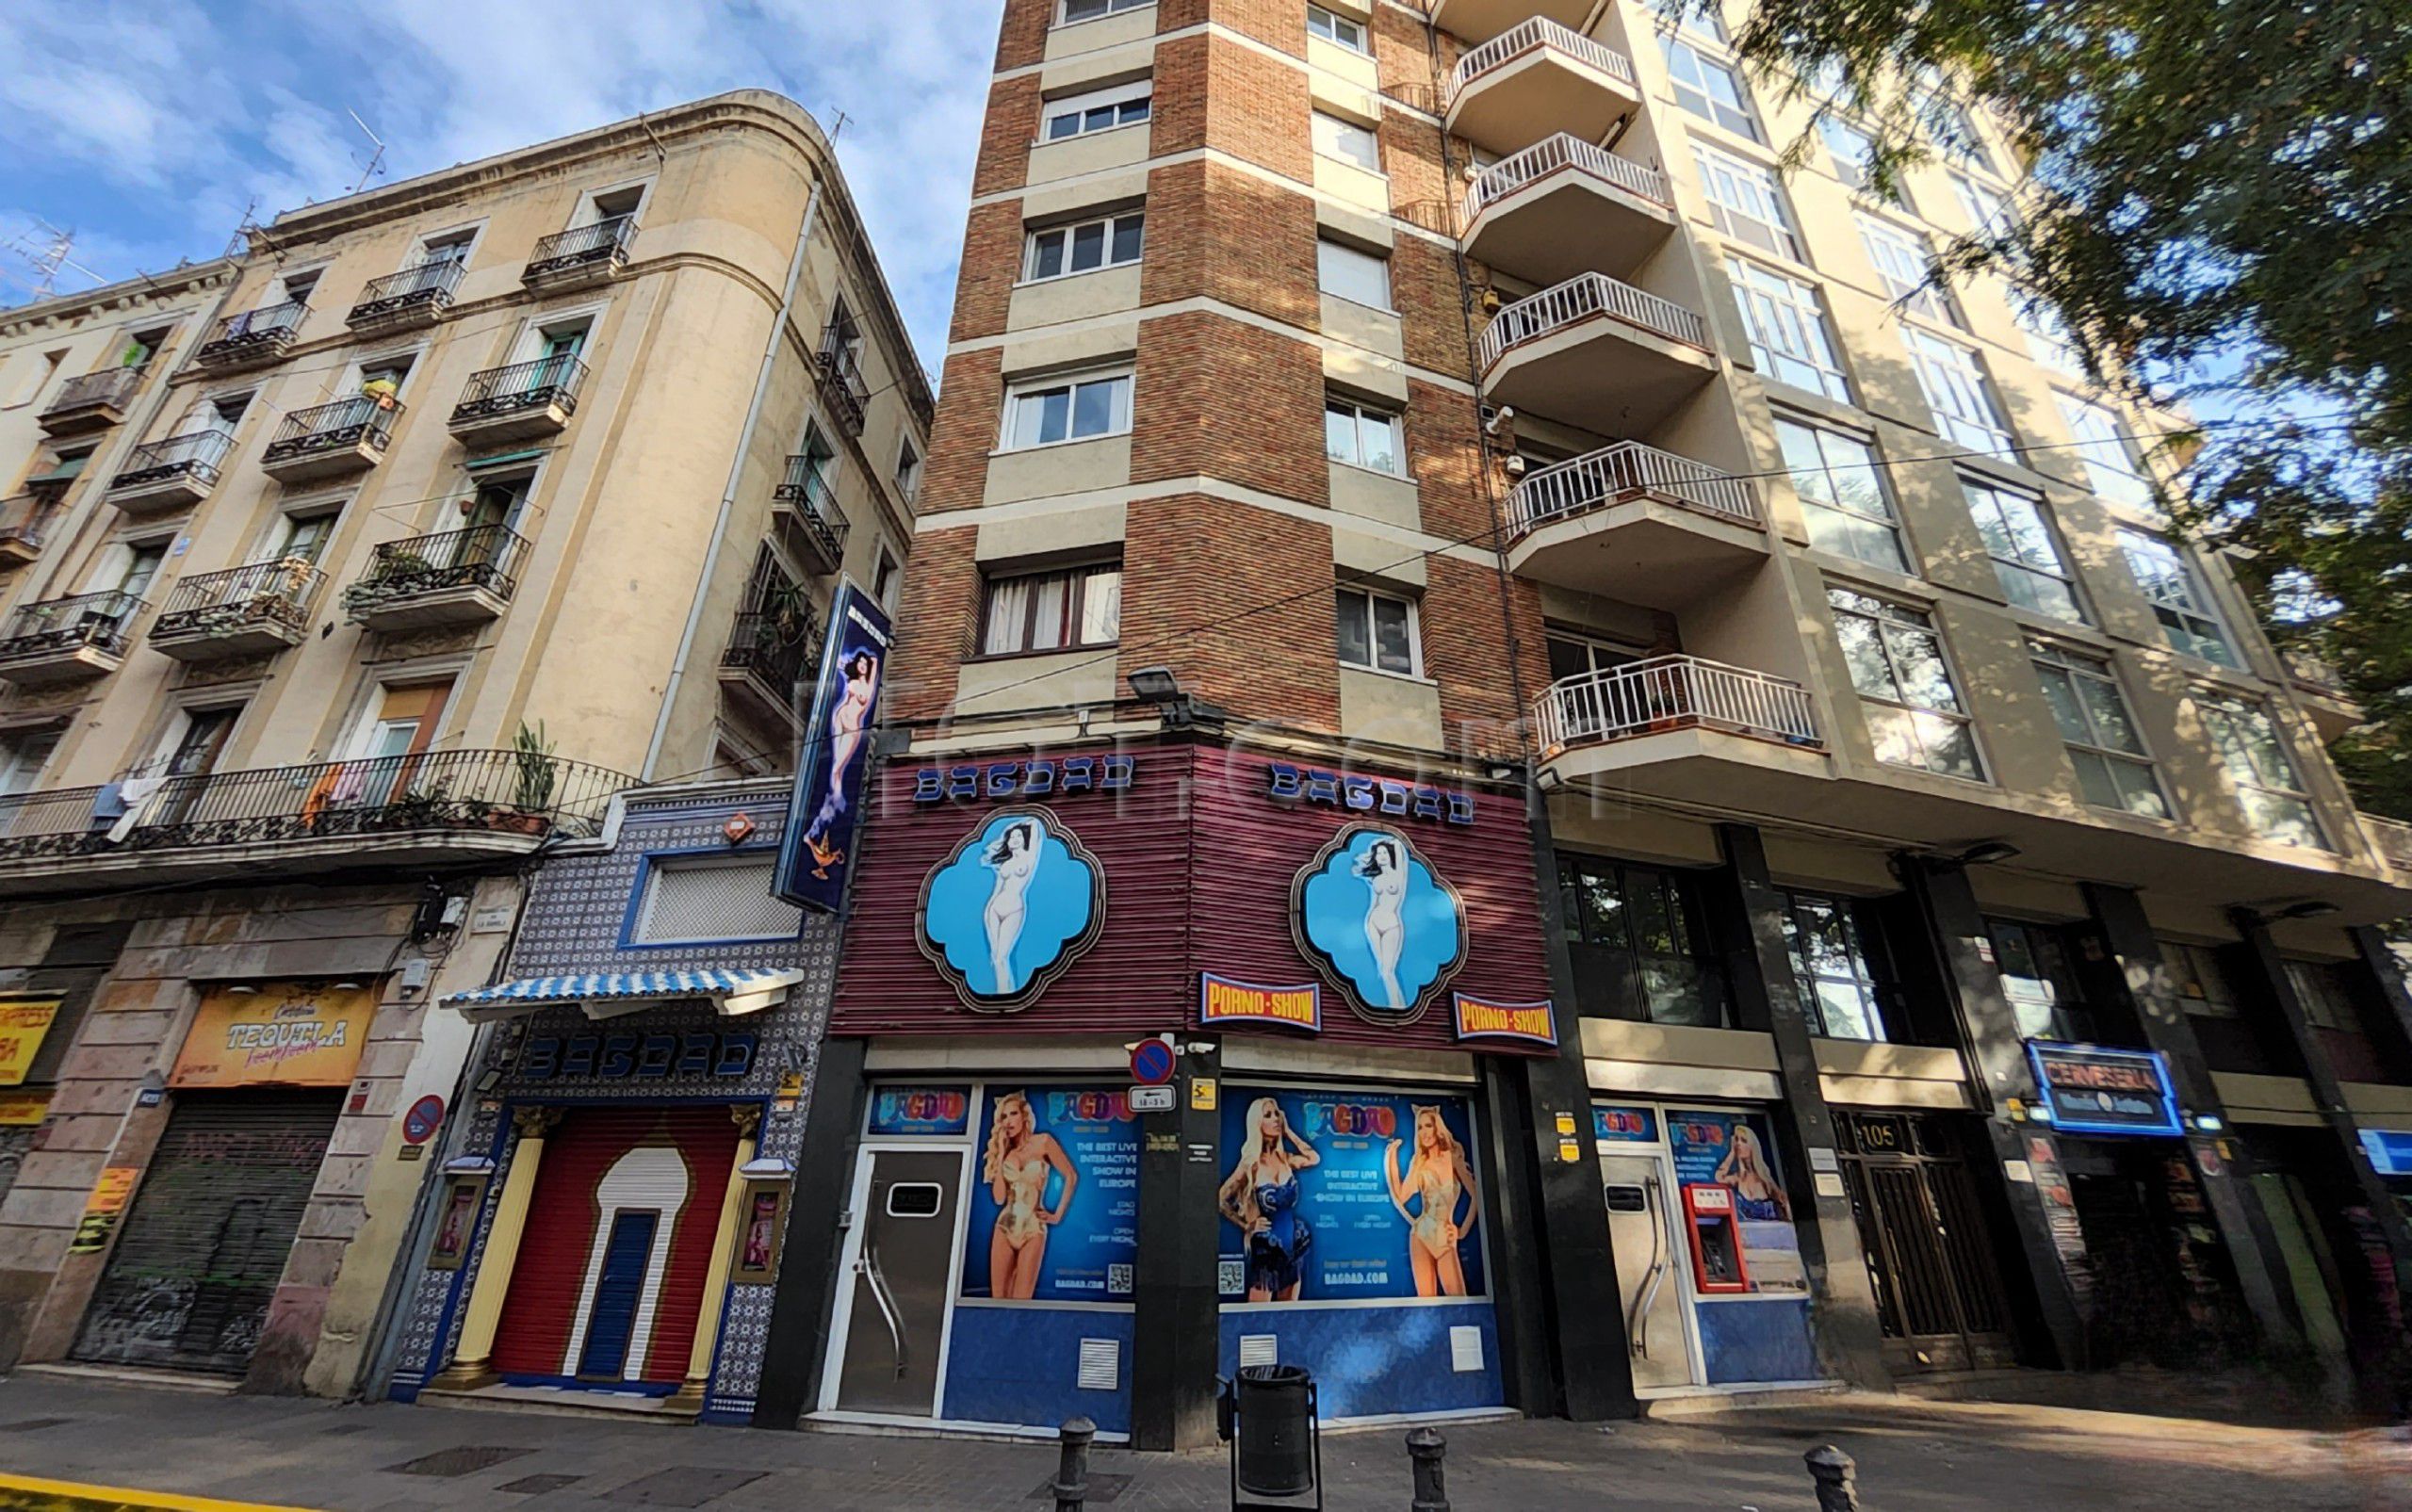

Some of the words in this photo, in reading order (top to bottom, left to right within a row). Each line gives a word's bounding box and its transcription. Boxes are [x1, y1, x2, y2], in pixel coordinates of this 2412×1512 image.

[913, 755, 1134, 802] BAGDAD
[1269, 761, 1475, 825] BAGDAD
[227, 1020, 348, 1049] TEQUILA
[524, 1034, 756, 1077] BAGDAD
[1304, 1102, 1396, 1140] BAGDAD
[1862, 1125, 1895, 1146] 105
[1324, 1273, 1388, 1285] BAGDAD.COM
